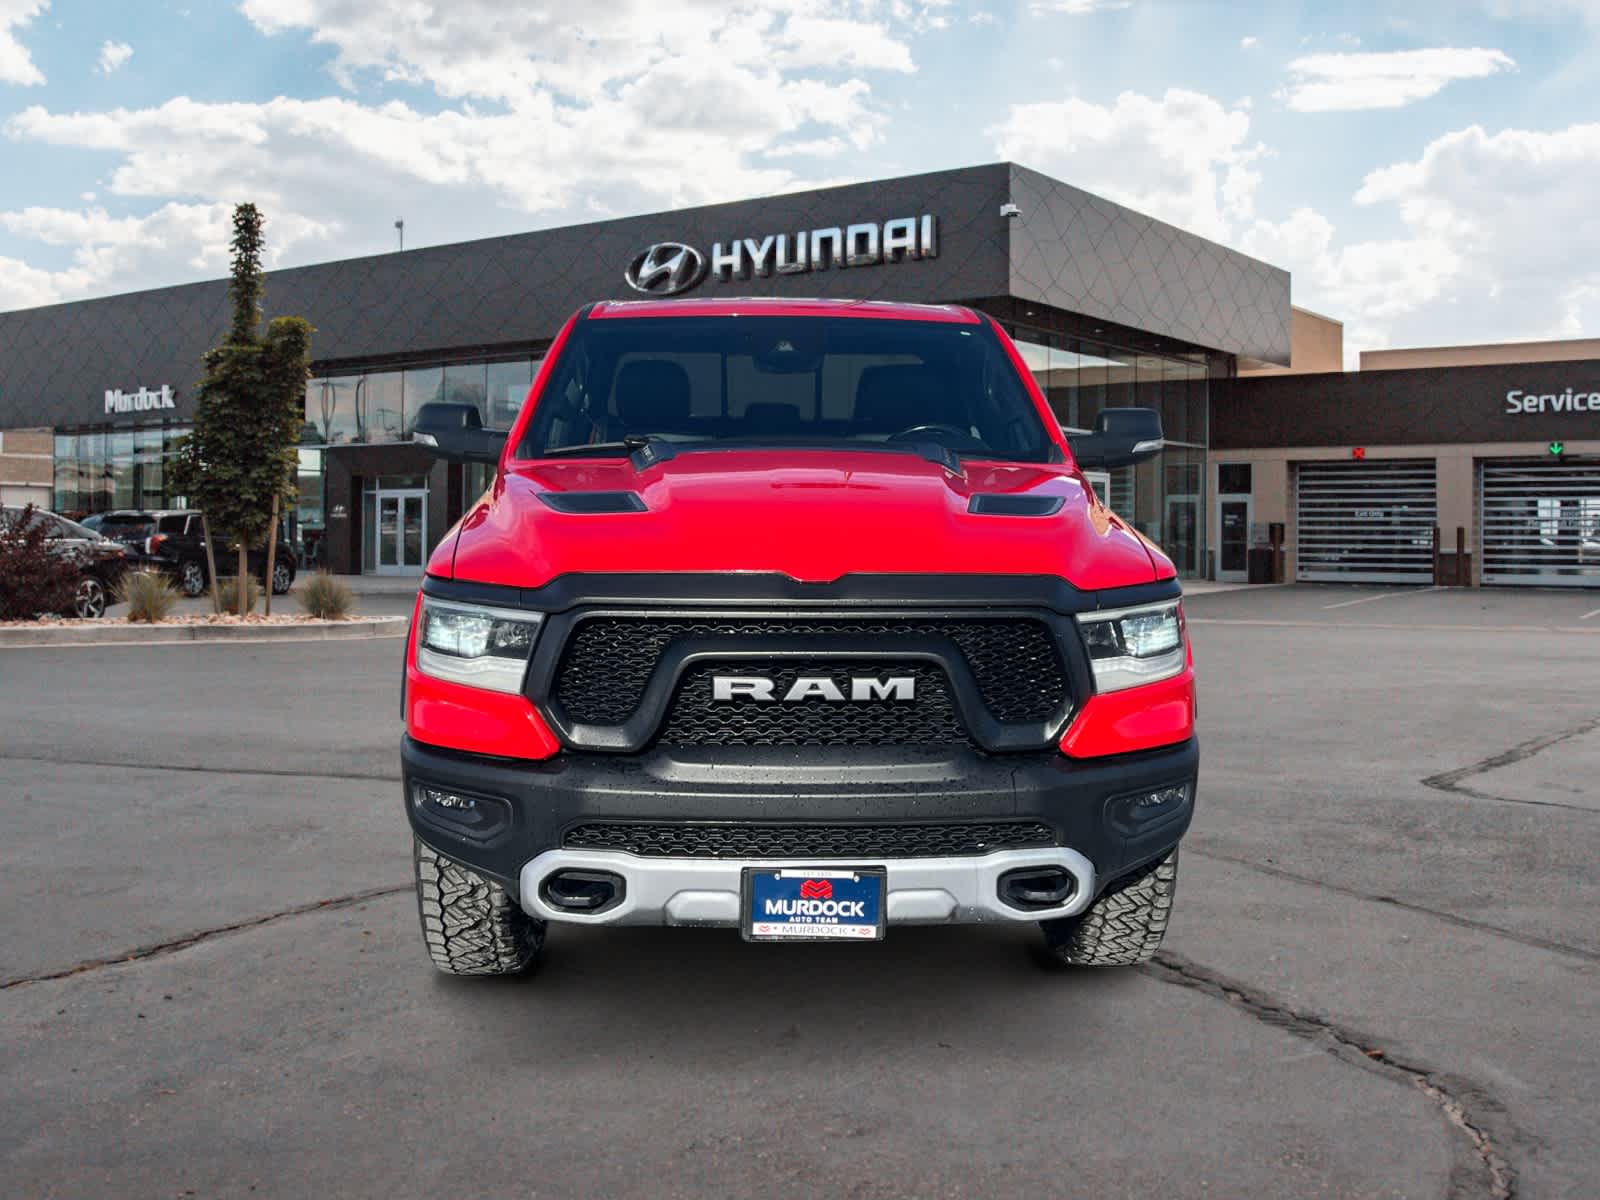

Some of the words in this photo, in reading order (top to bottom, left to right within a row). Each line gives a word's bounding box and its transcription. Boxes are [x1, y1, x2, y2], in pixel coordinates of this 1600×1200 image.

[711, 214, 936, 281] HYUNDAI
[104, 384, 175, 413] Murdock
[1505, 387, 1600, 413] Service
[713, 676, 915, 701] RAM
[765, 899, 865, 917] MURDOCK
[815, 916, 839, 924] TEAM
[782, 925, 848, 936] MURDOCK
